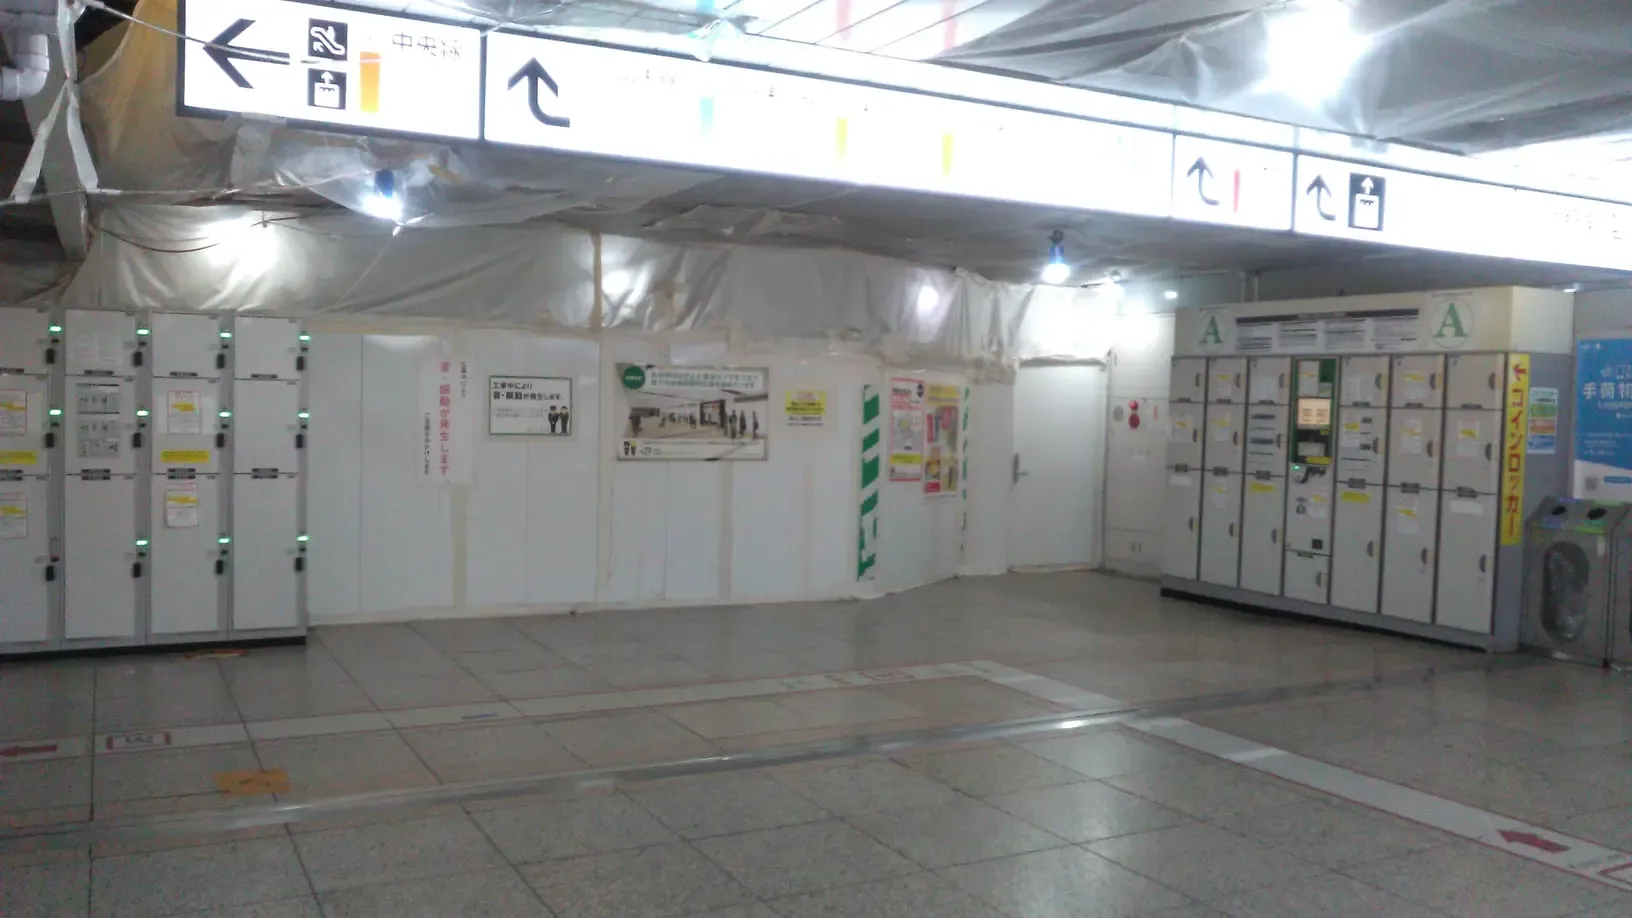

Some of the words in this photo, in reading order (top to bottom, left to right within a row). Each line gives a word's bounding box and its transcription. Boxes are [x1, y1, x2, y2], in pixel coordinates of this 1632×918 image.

[1200, 313, 1223, 345] A
[1435, 301, 1468, 339] A
[1505, 388, 1524, 537] コインロッカー
